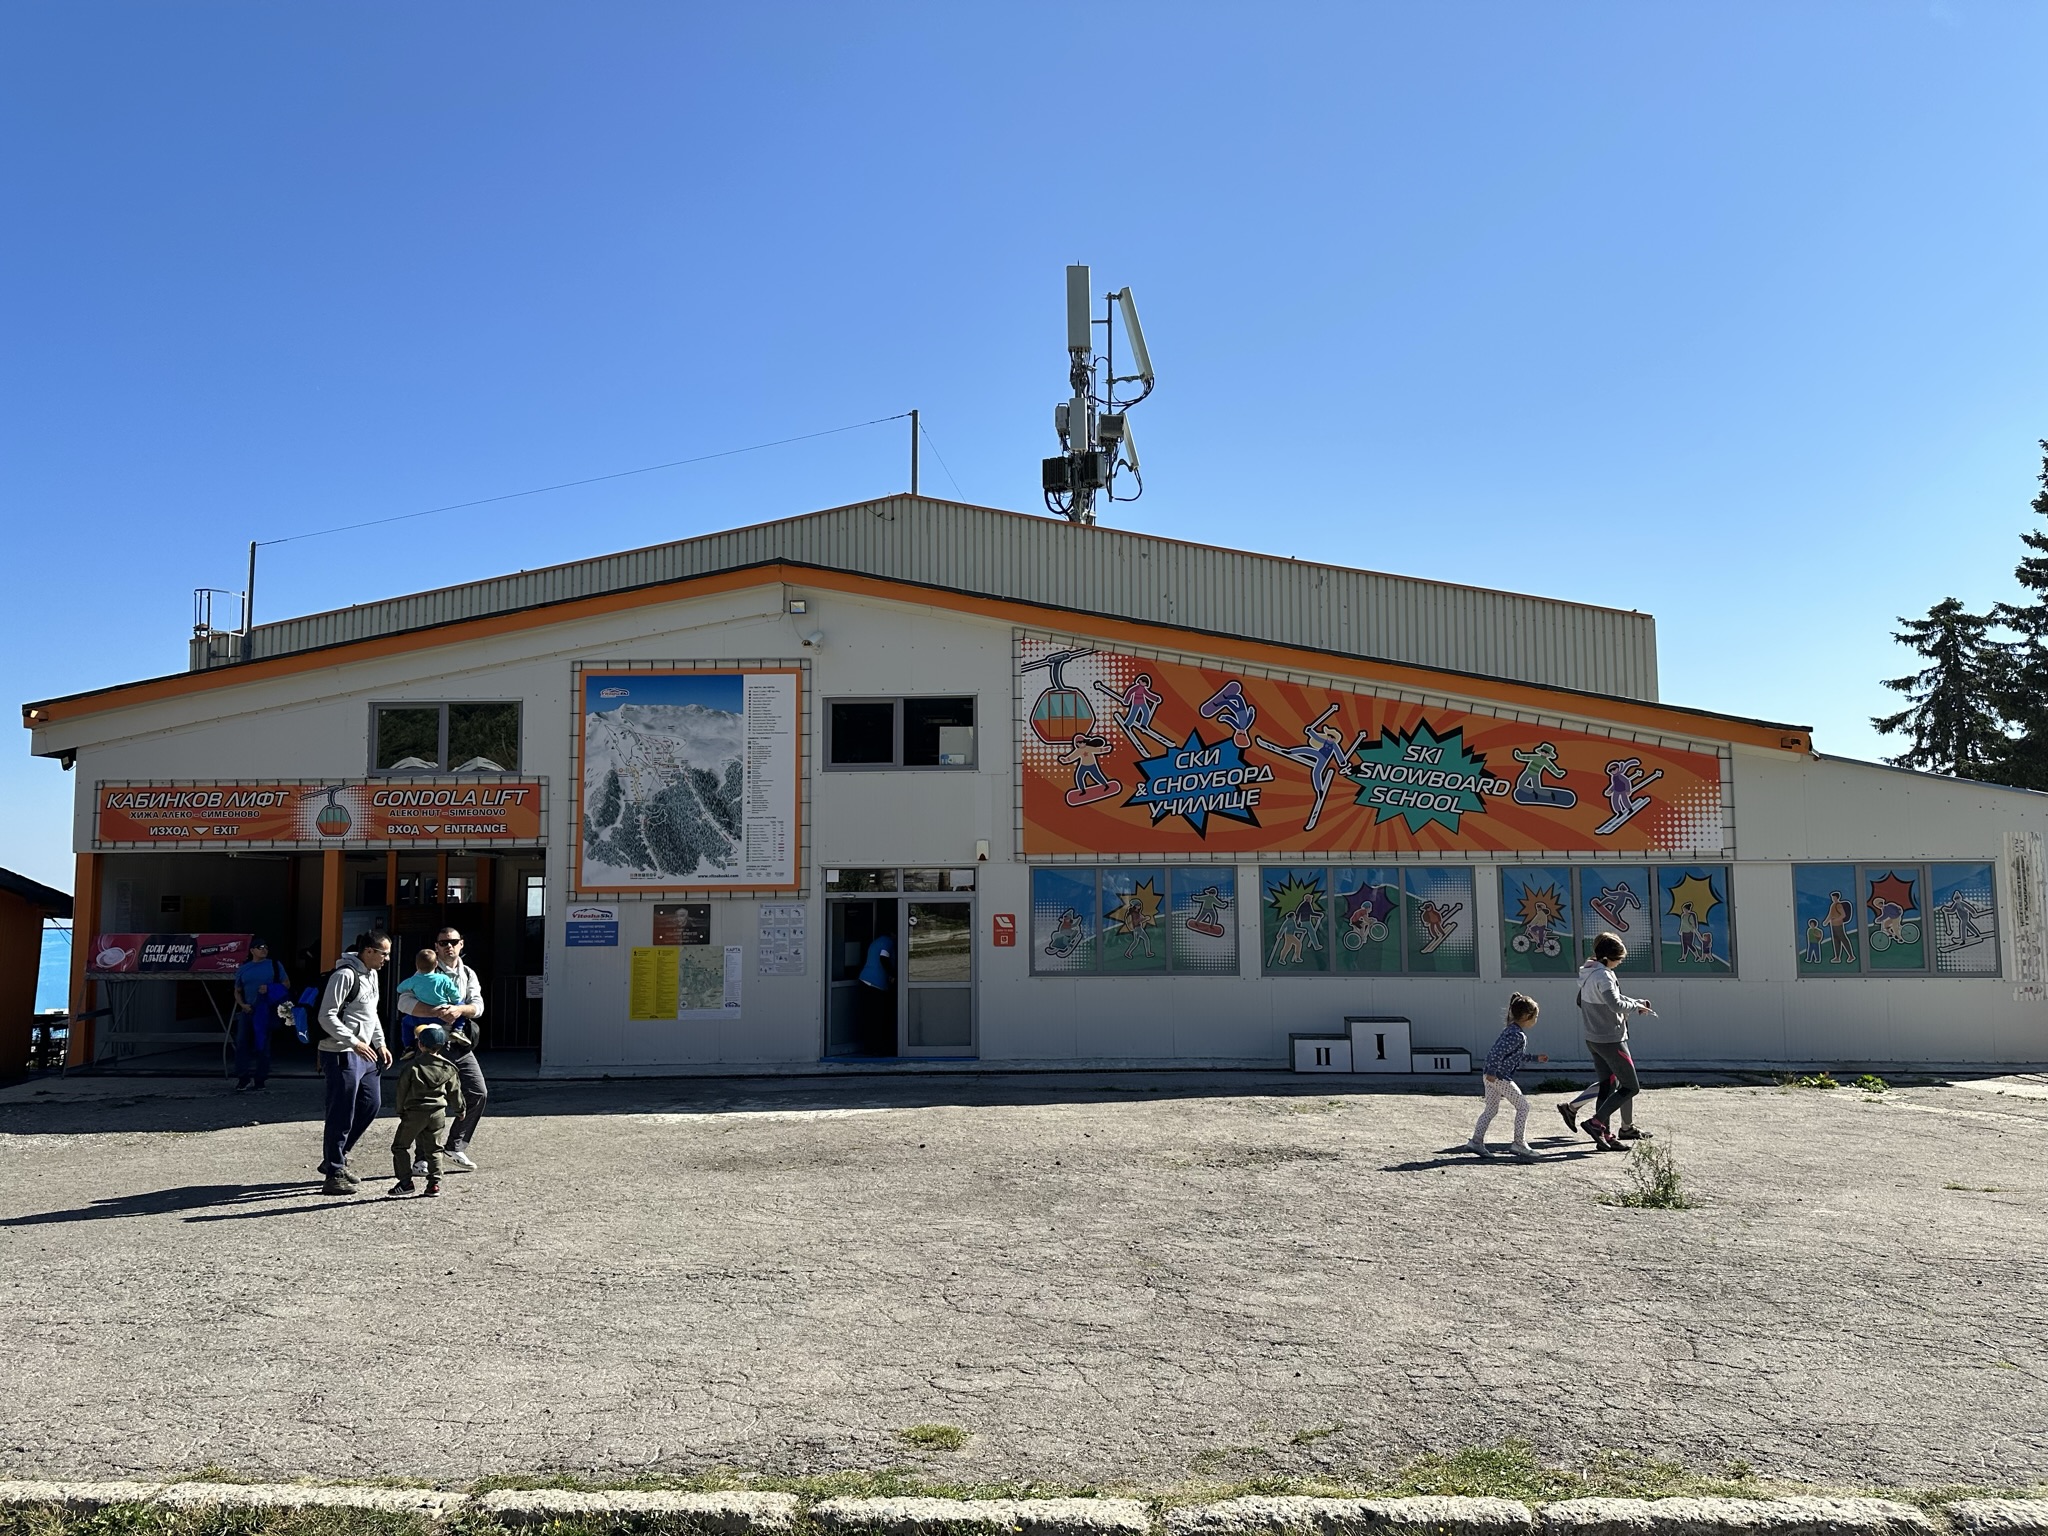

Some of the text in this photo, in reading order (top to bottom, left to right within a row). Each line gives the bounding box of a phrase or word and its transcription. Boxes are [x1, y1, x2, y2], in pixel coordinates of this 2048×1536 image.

[1175, 748, 1220, 769] СКИ
[1403, 745, 1444, 765] SKI
[1135, 764, 1275, 797] & СНОУБОРД
[1339, 762, 1511, 796] & SNOWBOARD
[106, 791, 290, 810] КАБИНКОВ ЛИФТ
[373, 789, 529, 807] GONDOLA LIFT
[1149, 788, 1261, 819] УЧИЛИЩЕ
[1369, 786, 1464, 814] SCHOOL
[130, 811, 159, 819] ХИЖА
[389, 809, 420, 817] ALEKO
[421, 809, 441, 817] HUT
[449, 808, 506, 816] SIMEONOVO
[149, 826, 190, 837] ИЗХОД
[213, 826, 240, 835] EXIT
[387, 825, 420, 836] ВХОД
[444, 824, 507, 833] ENTRANCE
[142, 953, 190, 964] ПЛЪТЕН ВКУС!
[145, 944, 194, 955] БОГАТ АРОМАТ,
[1375, 1034, 1387, 1060] I
[1316, 1047, 1332, 1066] II
[1434, 1058, 1451, 1069] III
